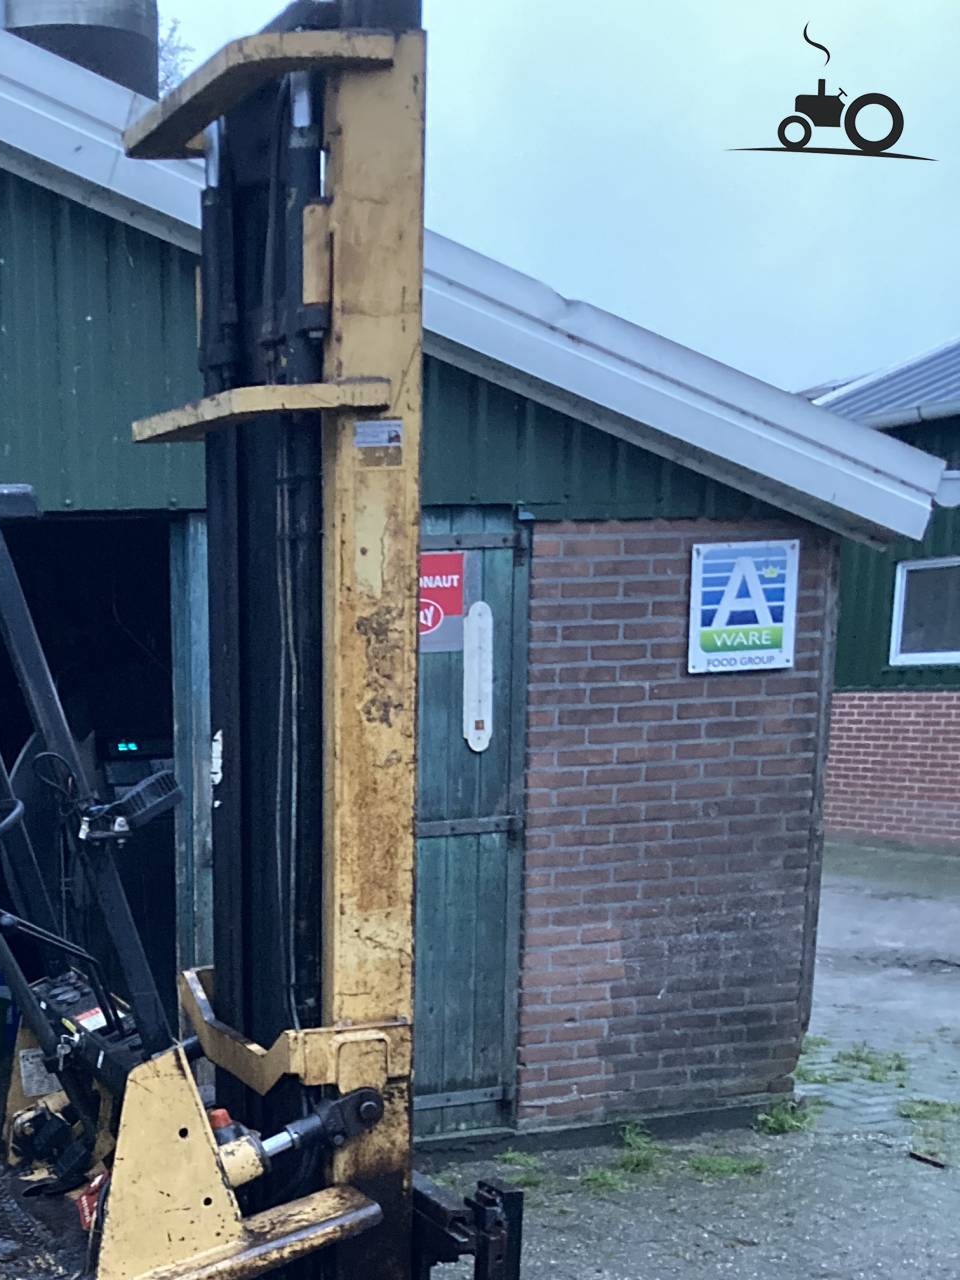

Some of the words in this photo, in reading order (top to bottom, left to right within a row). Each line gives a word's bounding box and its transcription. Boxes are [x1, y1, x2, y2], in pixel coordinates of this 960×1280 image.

[711, 556, 774, 627] A
[712, 631, 772, 647] WARE
[707, 656, 737, 668] FOOD
[741, 655, 775, 666] GROUP
